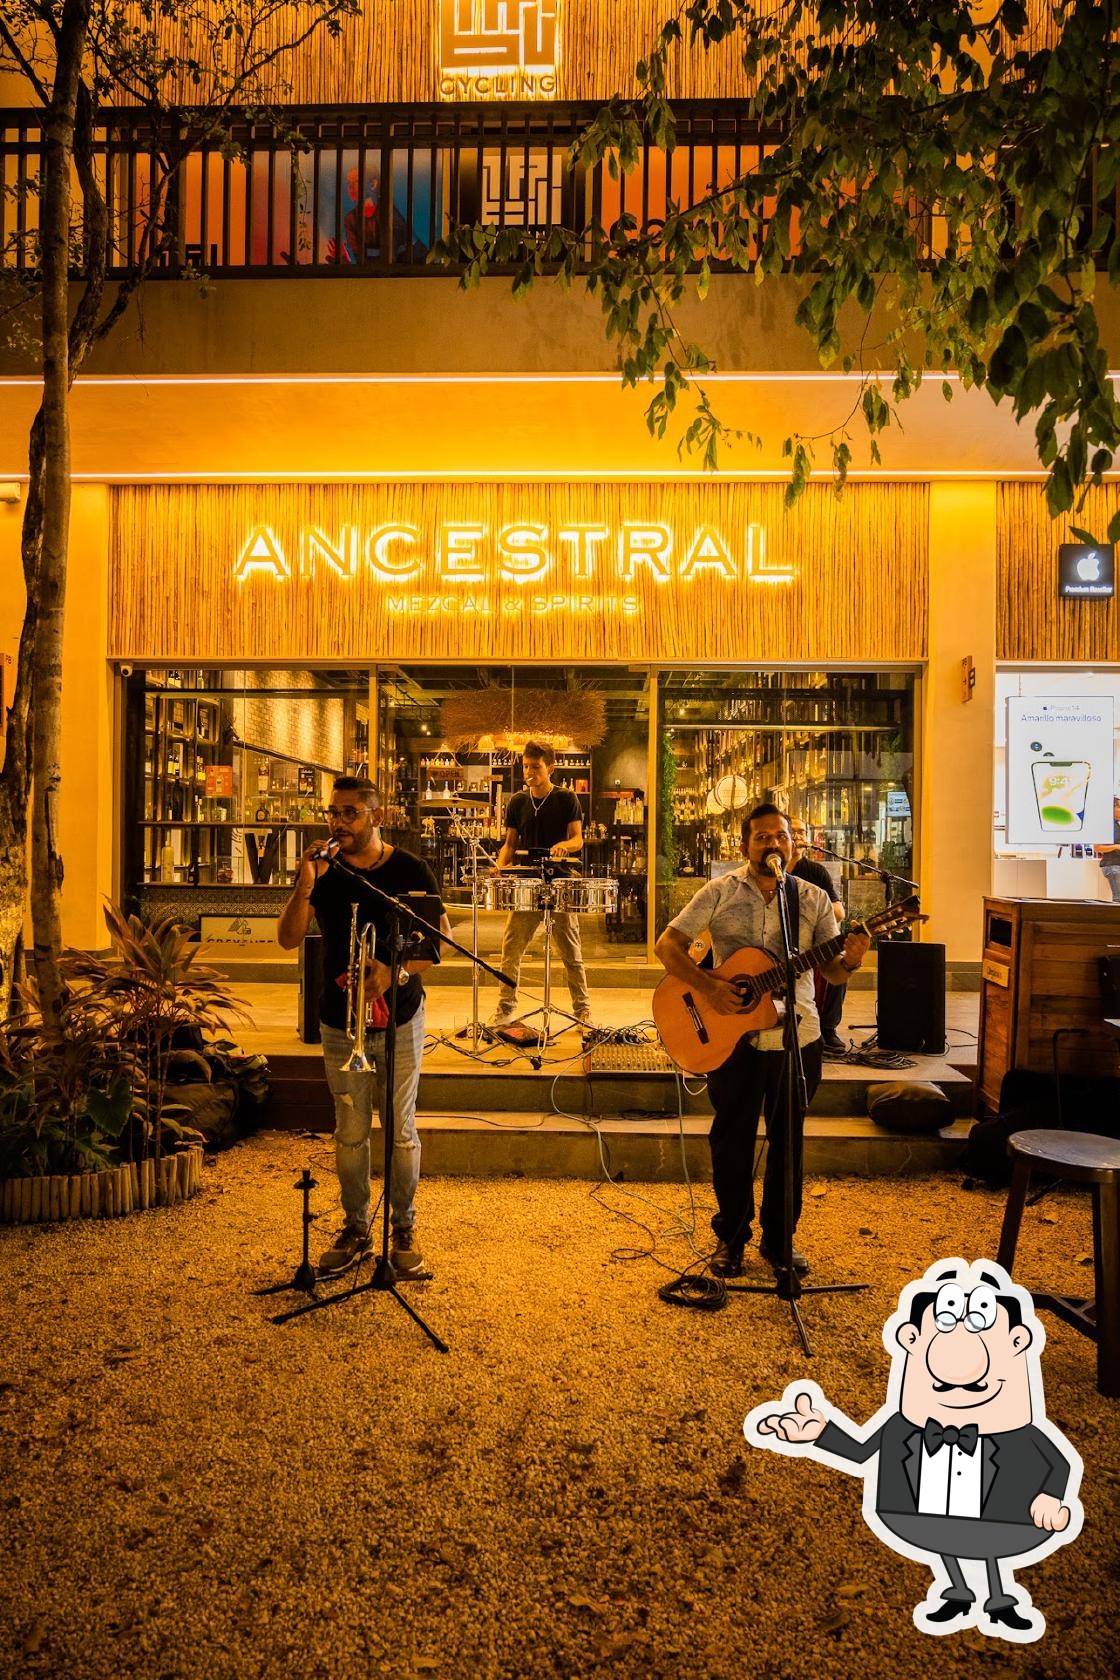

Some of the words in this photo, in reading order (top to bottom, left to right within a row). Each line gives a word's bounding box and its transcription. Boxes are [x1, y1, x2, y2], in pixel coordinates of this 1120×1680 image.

[440, 75, 556, 95] CYCLING
[234, 524, 796, 577] ANCESTRAL
[387, 596, 496, 612] MEZCAL
[504, 599, 521, 611] &
[532, 596, 639, 612] SPIRITS
[1021, 713, 1055, 722] Amarillo
[1056, 713, 1102, 722] maravilloso
